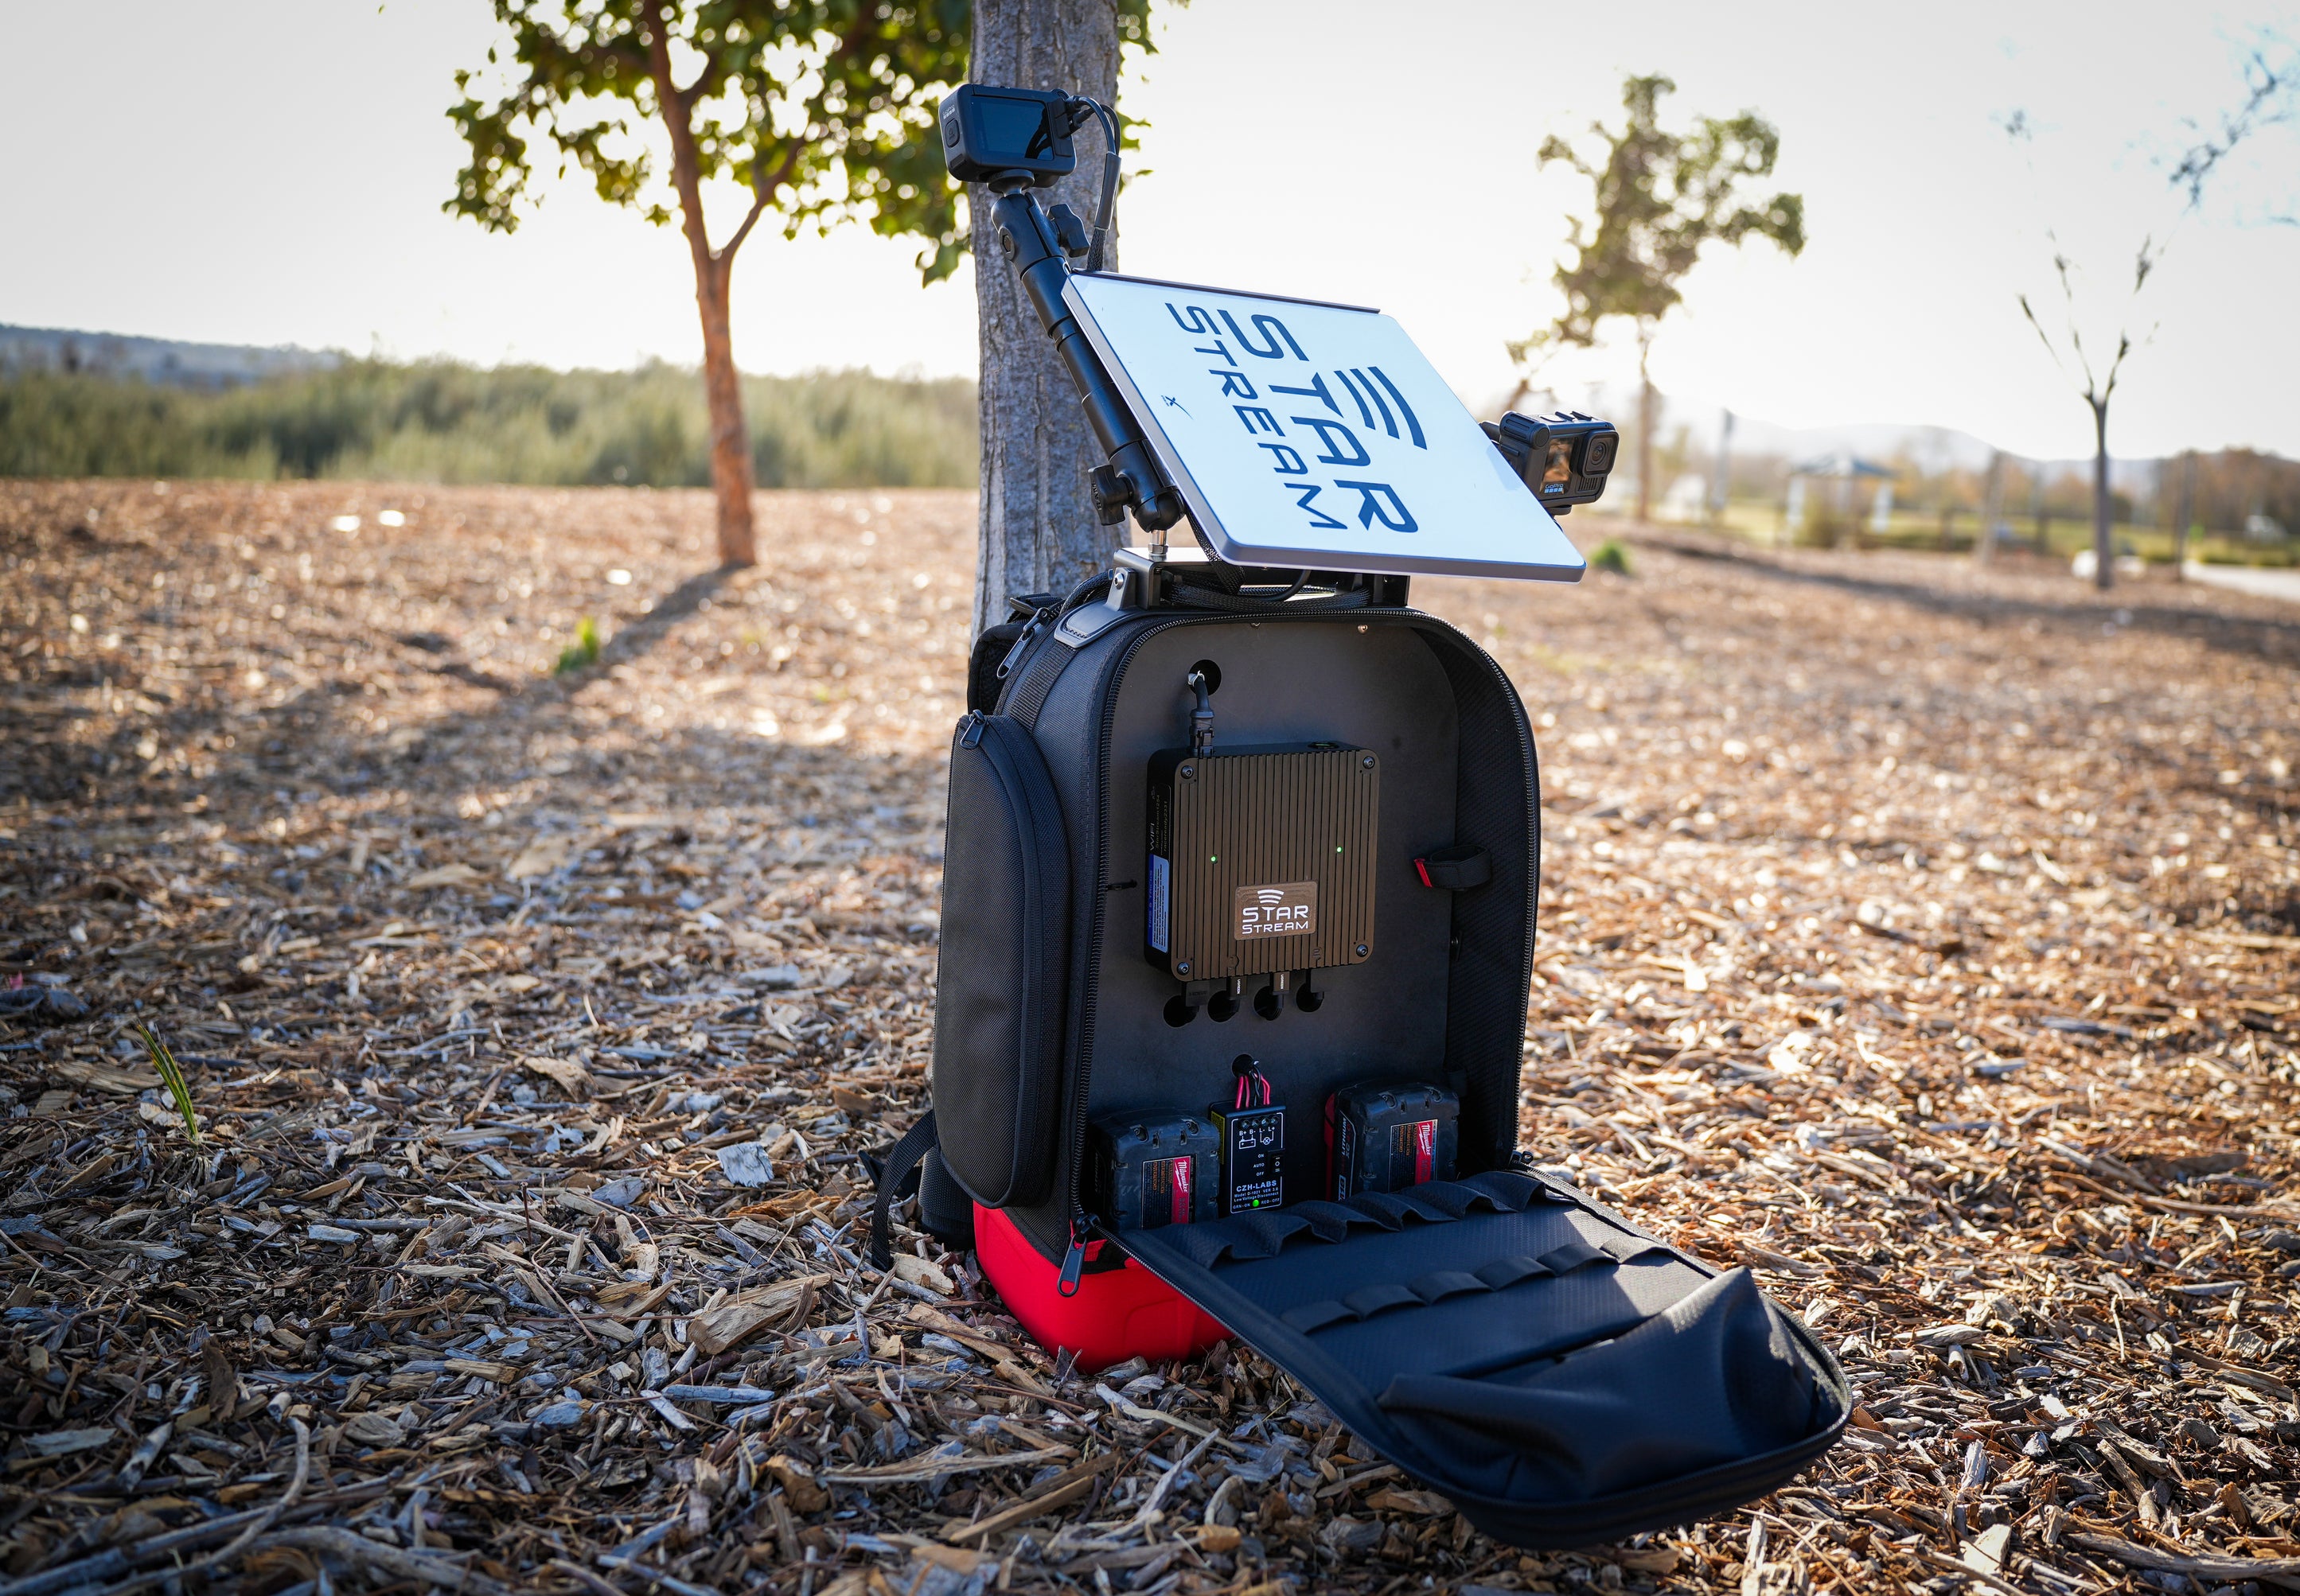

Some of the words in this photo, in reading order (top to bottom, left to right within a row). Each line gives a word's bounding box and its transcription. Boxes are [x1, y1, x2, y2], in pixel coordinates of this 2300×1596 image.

[1164, 302, 1348, 530] STREAM
[1216, 309, 1418, 533] STAR
[1242, 905, 1309, 923] STAR
[1242, 921, 1309, 935] STREAM
[1421, 1123, 1432, 1156] Milwaukee
[1178, 1159, 1188, 1193] Milwaukee
[1236, 1180, 1277, 1192] CZH-LABS
